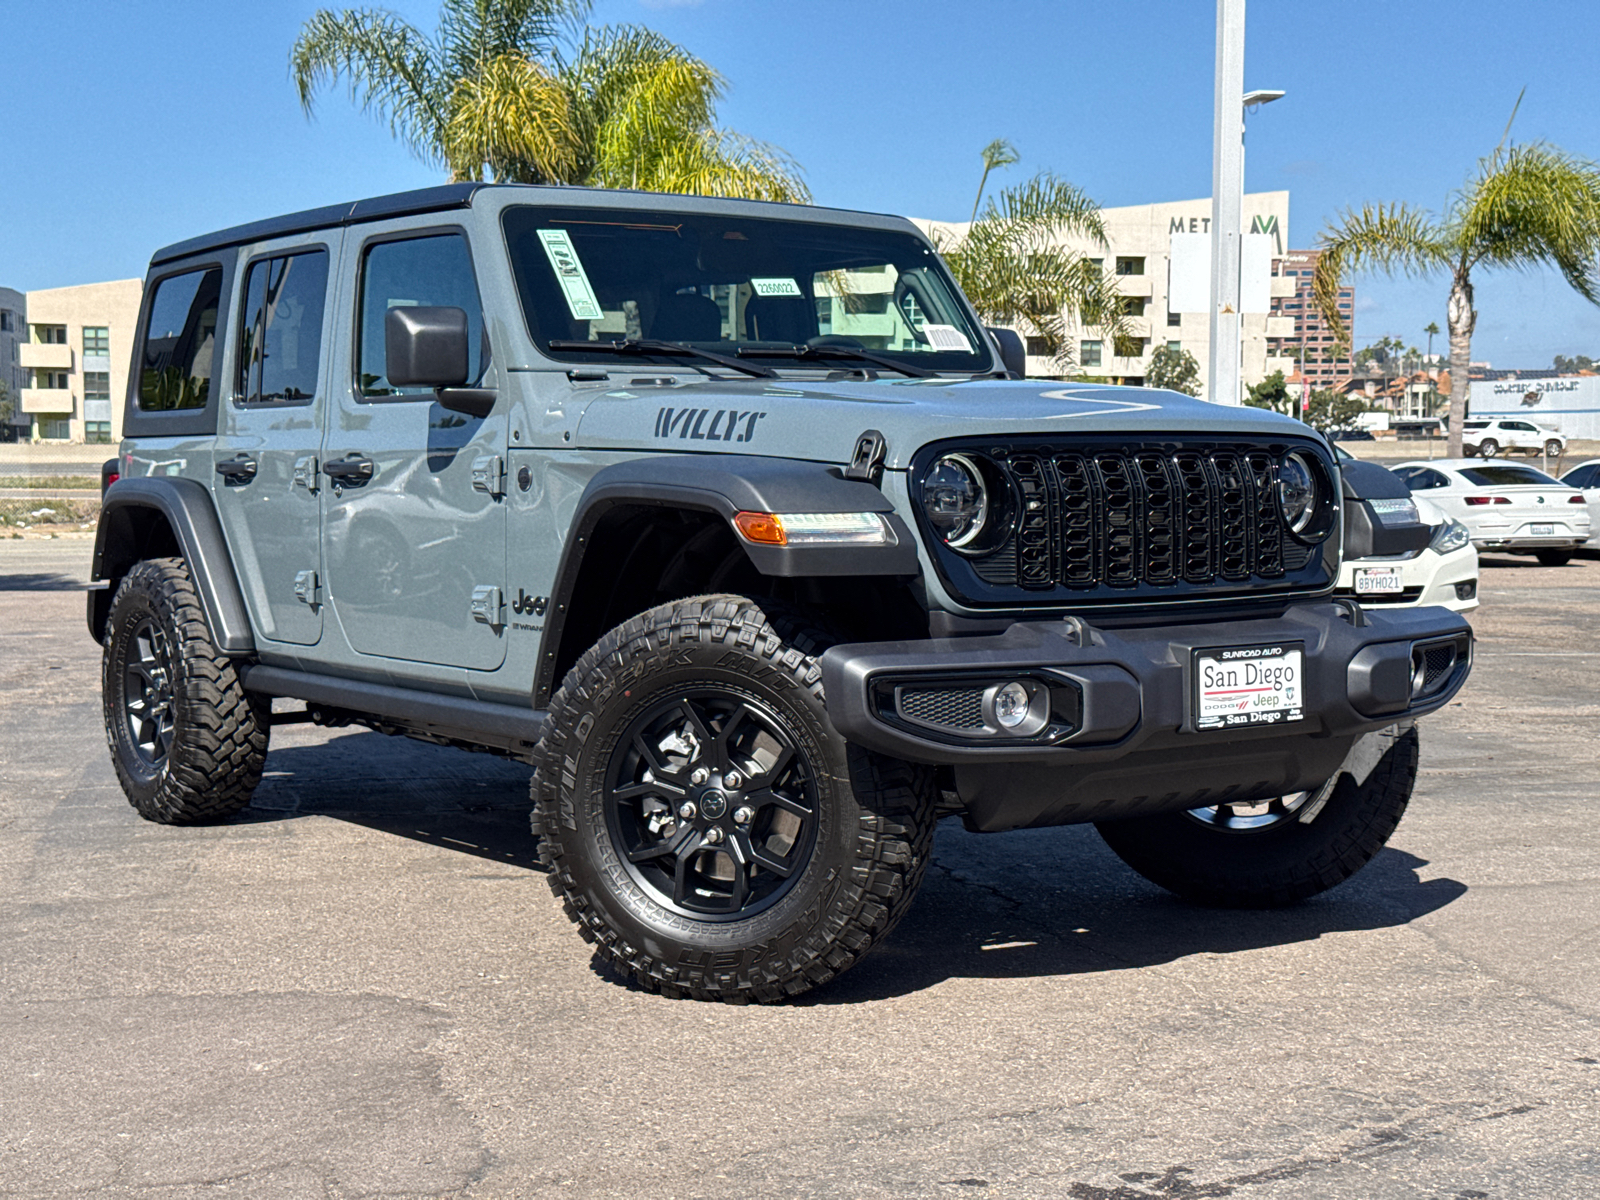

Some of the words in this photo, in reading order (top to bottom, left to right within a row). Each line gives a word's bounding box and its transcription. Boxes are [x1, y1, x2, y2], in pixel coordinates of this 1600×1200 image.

[1168, 216, 1211, 235] MET
[654, 407, 767, 442] WILLYS
[1358, 576, 1400, 590] 8BYH021
[1222, 649, 1261, 660] SUNROAD
[1261, 647, 1282, 657] AUTO
[1204, 665, 1238, 688] San
[1244, 661, 1294, 691] Diego
[1253, 693, 1280, 708] Jeep
[1226, 714, 1248, 725] San
[1249, 711, 1281, 723] Diego
